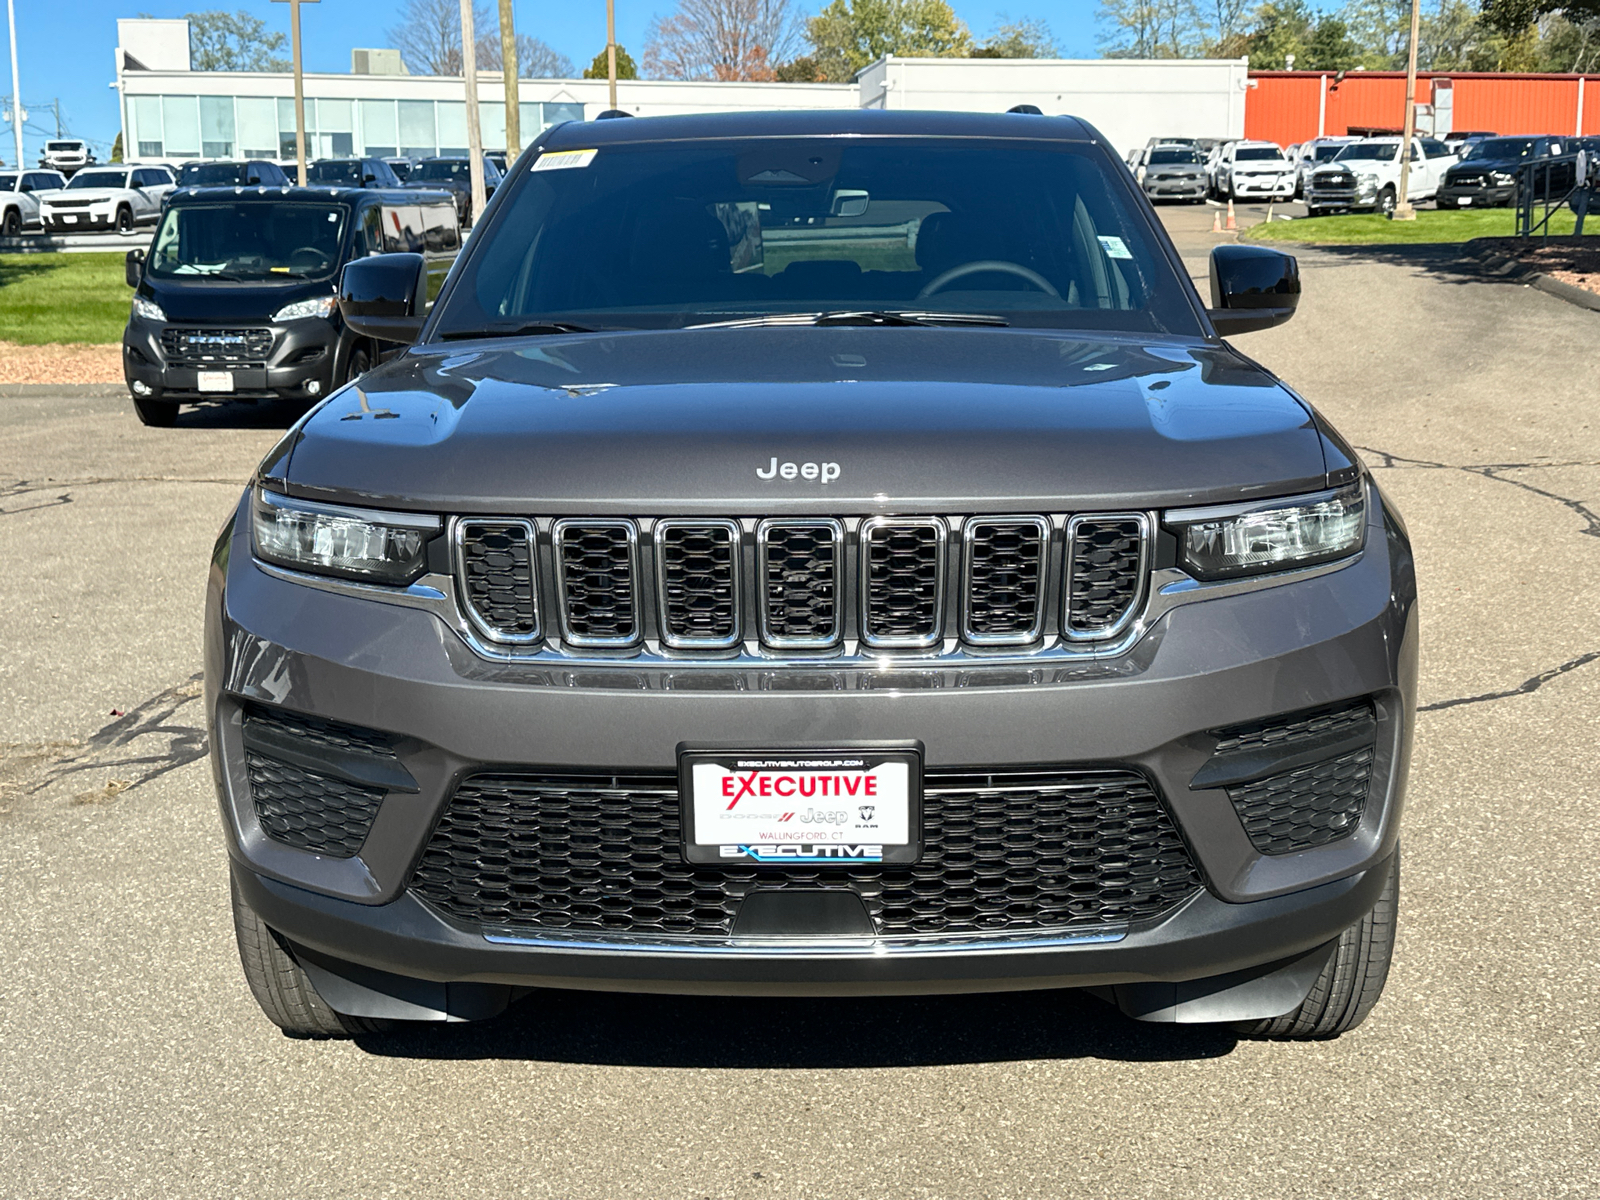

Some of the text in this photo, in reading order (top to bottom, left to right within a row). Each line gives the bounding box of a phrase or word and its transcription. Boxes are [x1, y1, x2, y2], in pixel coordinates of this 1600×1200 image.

[756, 457, 841, 484] Jeep
[721, 771, 878, 810] EXECUTIVE
[800, 808, 848, 826] Jeep
[832, 831, 844, 840] CT
[719, 845, 883, 859] EXECUTIVE
